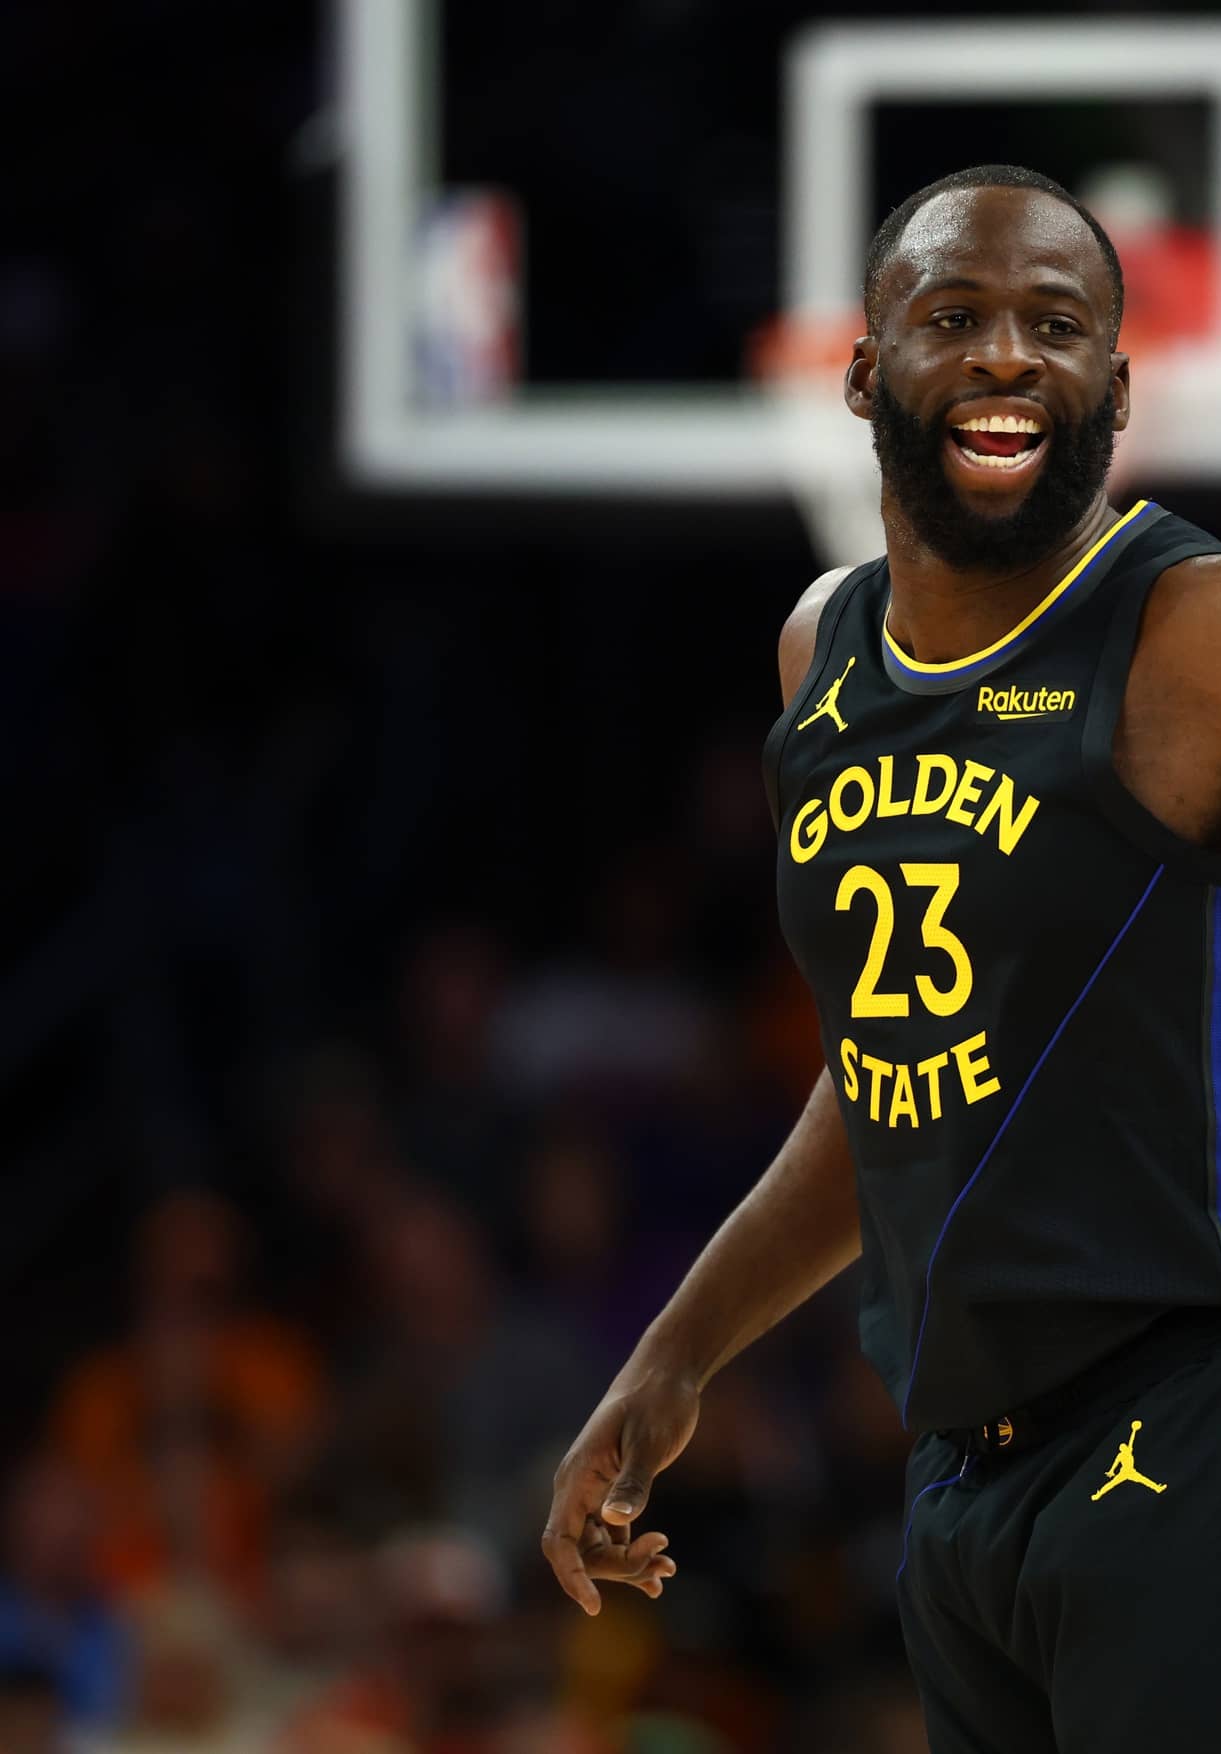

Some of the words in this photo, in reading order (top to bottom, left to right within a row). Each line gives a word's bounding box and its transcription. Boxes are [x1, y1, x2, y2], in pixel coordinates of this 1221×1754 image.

[977, 685, 1076, 712] Rakuten
[789, 754, 1041, 864] GOLDEN
[834, 863, 974, 1019] 23
[840, 1030, 1002, 1129] STATE
